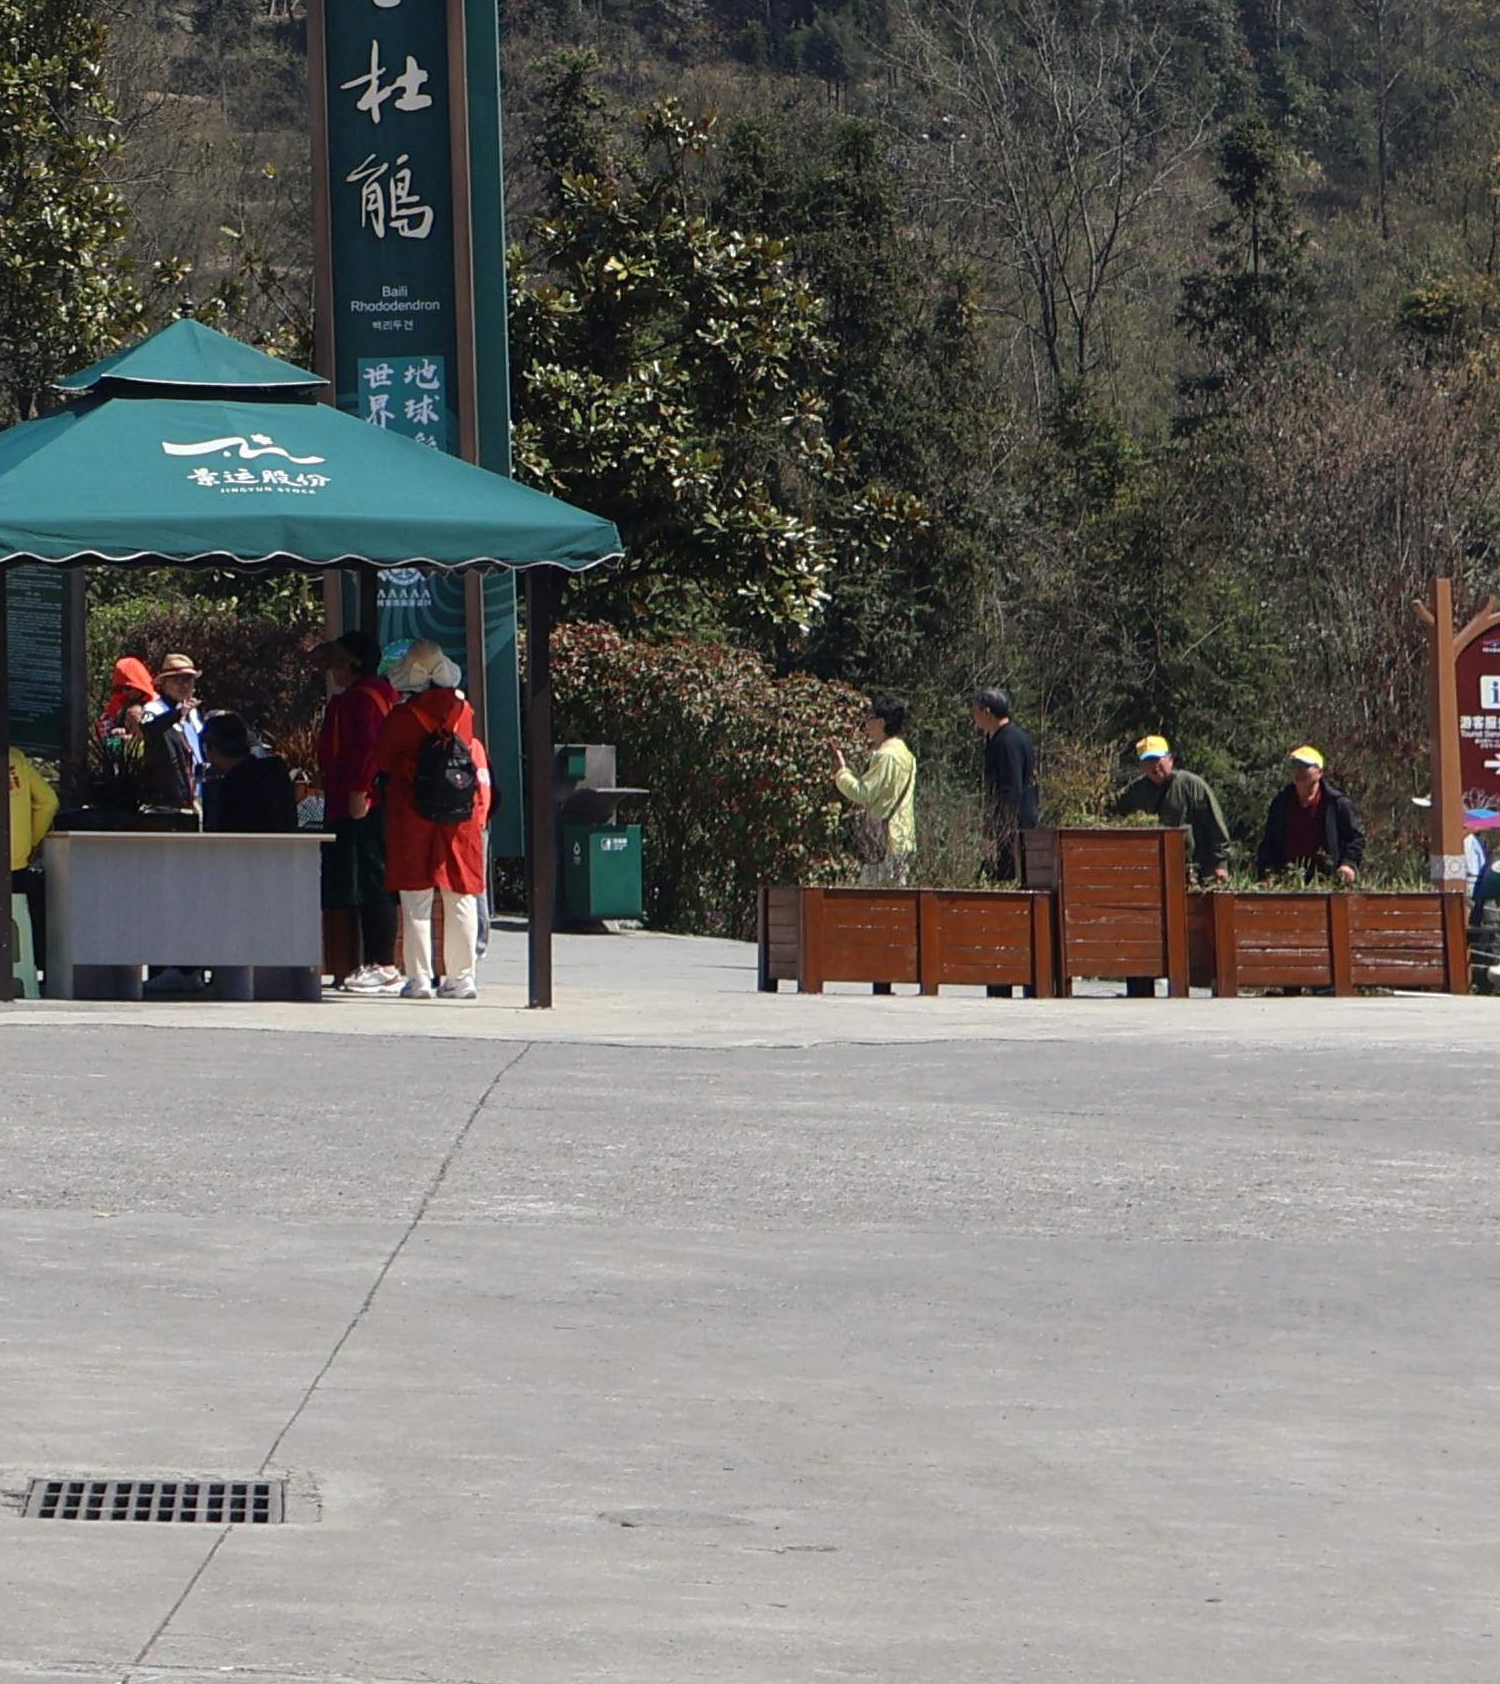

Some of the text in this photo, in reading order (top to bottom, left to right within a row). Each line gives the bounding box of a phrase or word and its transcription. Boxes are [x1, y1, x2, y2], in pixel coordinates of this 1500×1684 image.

[382, 285, 408, 298] Baili
[350, 300, 440, 313] Rhododendron
[187, 468, 332, 487] 景运股份
[277, 487, 316, 495] STOCK
